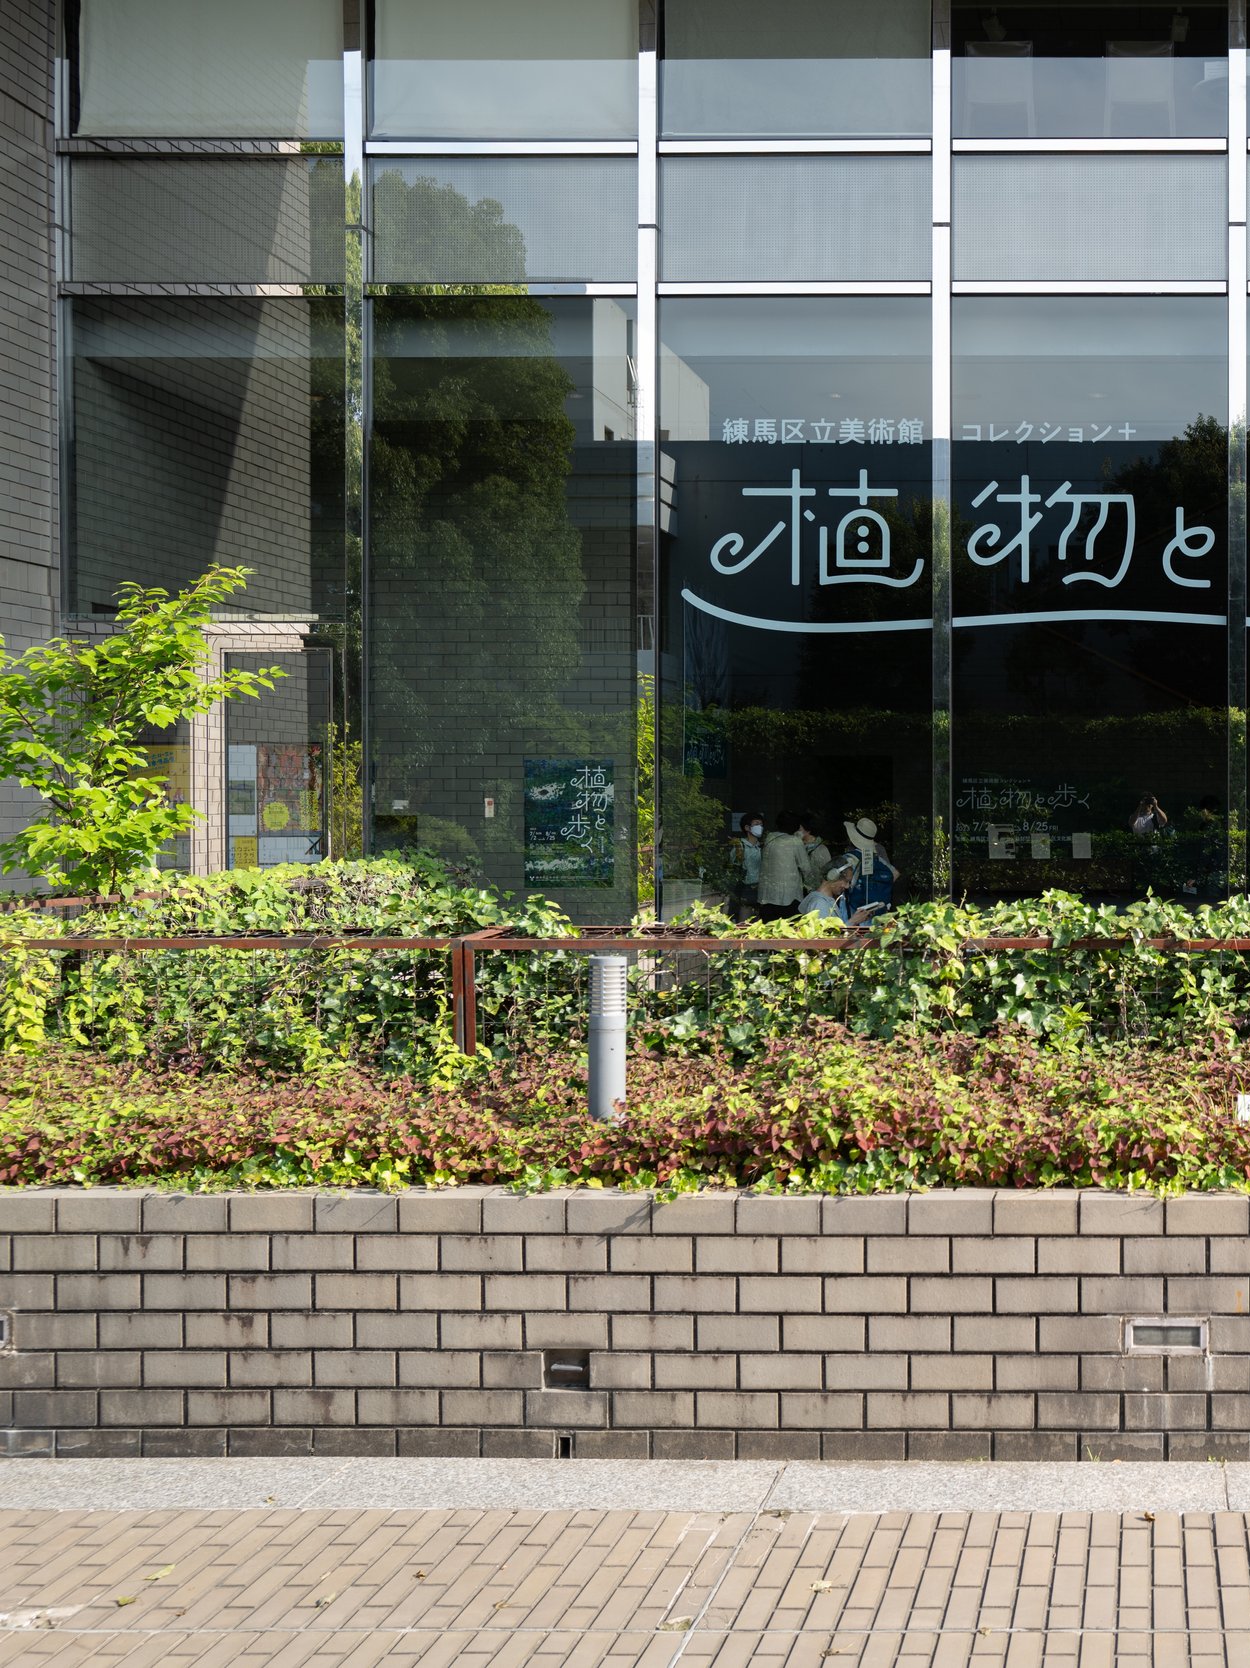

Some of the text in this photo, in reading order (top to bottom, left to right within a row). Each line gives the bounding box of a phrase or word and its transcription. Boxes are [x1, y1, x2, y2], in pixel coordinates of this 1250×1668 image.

[722, 418, 924, 445] 練馬区立美術館
[956, 783, 1090, 810] 植物と歩く
[1023, 821, 1048, 832] 8/25
